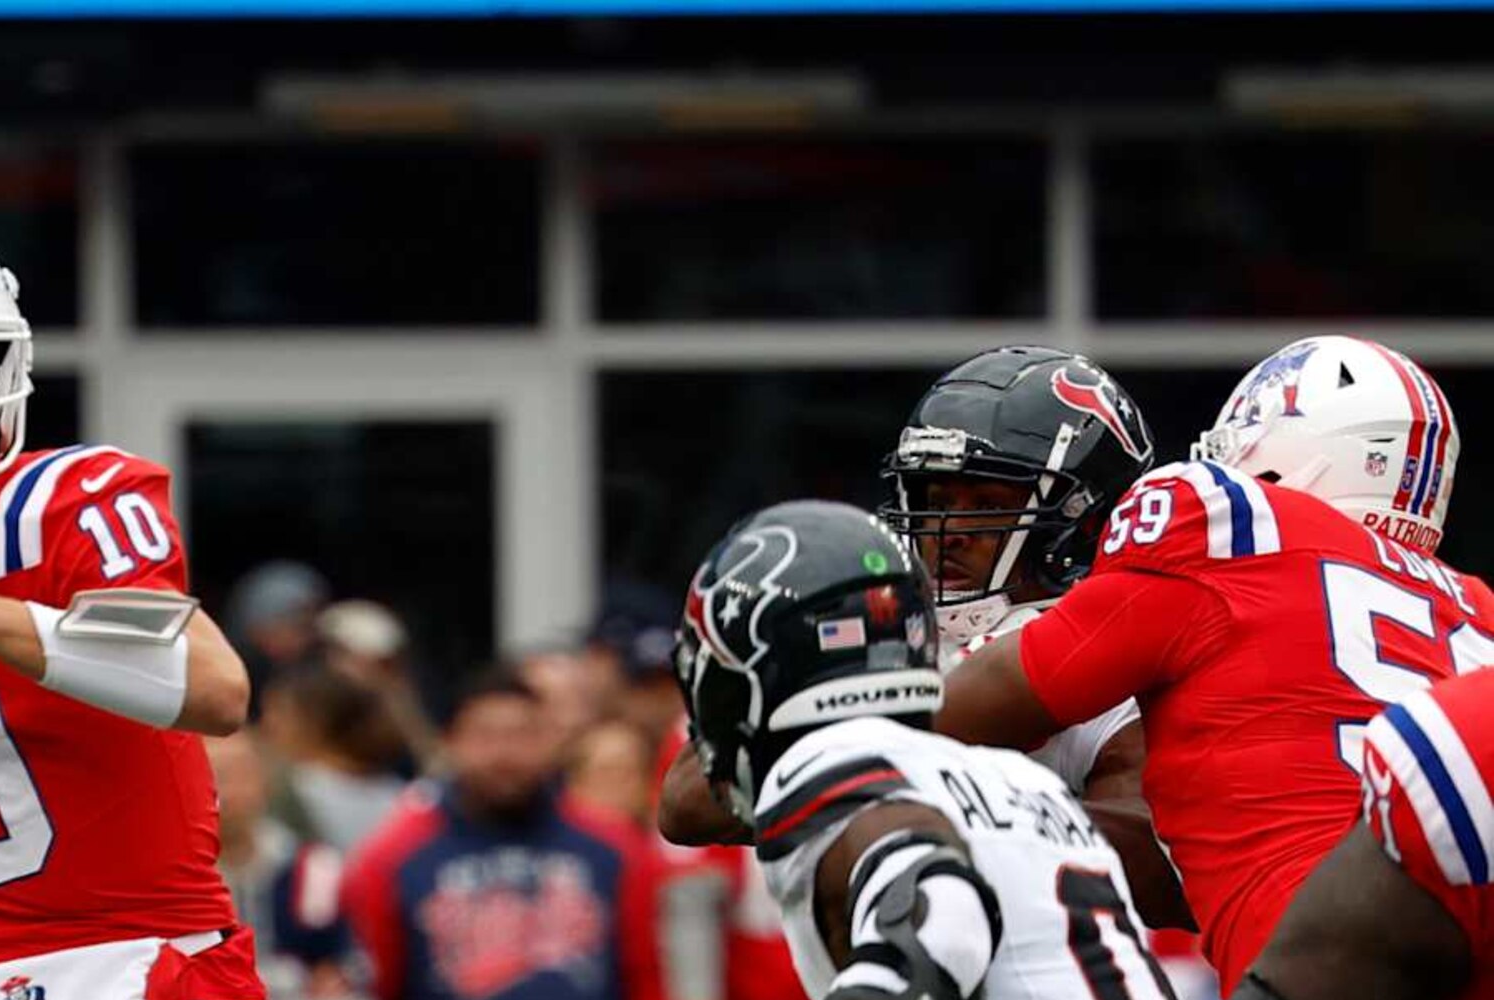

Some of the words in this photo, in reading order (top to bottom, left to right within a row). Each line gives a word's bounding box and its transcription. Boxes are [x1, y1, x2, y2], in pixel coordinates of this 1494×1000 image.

[79, 492, 171, 581] 10
[1103, 488, 1174, 554] 59
[816, 685, 939, 712] HOUSTON
